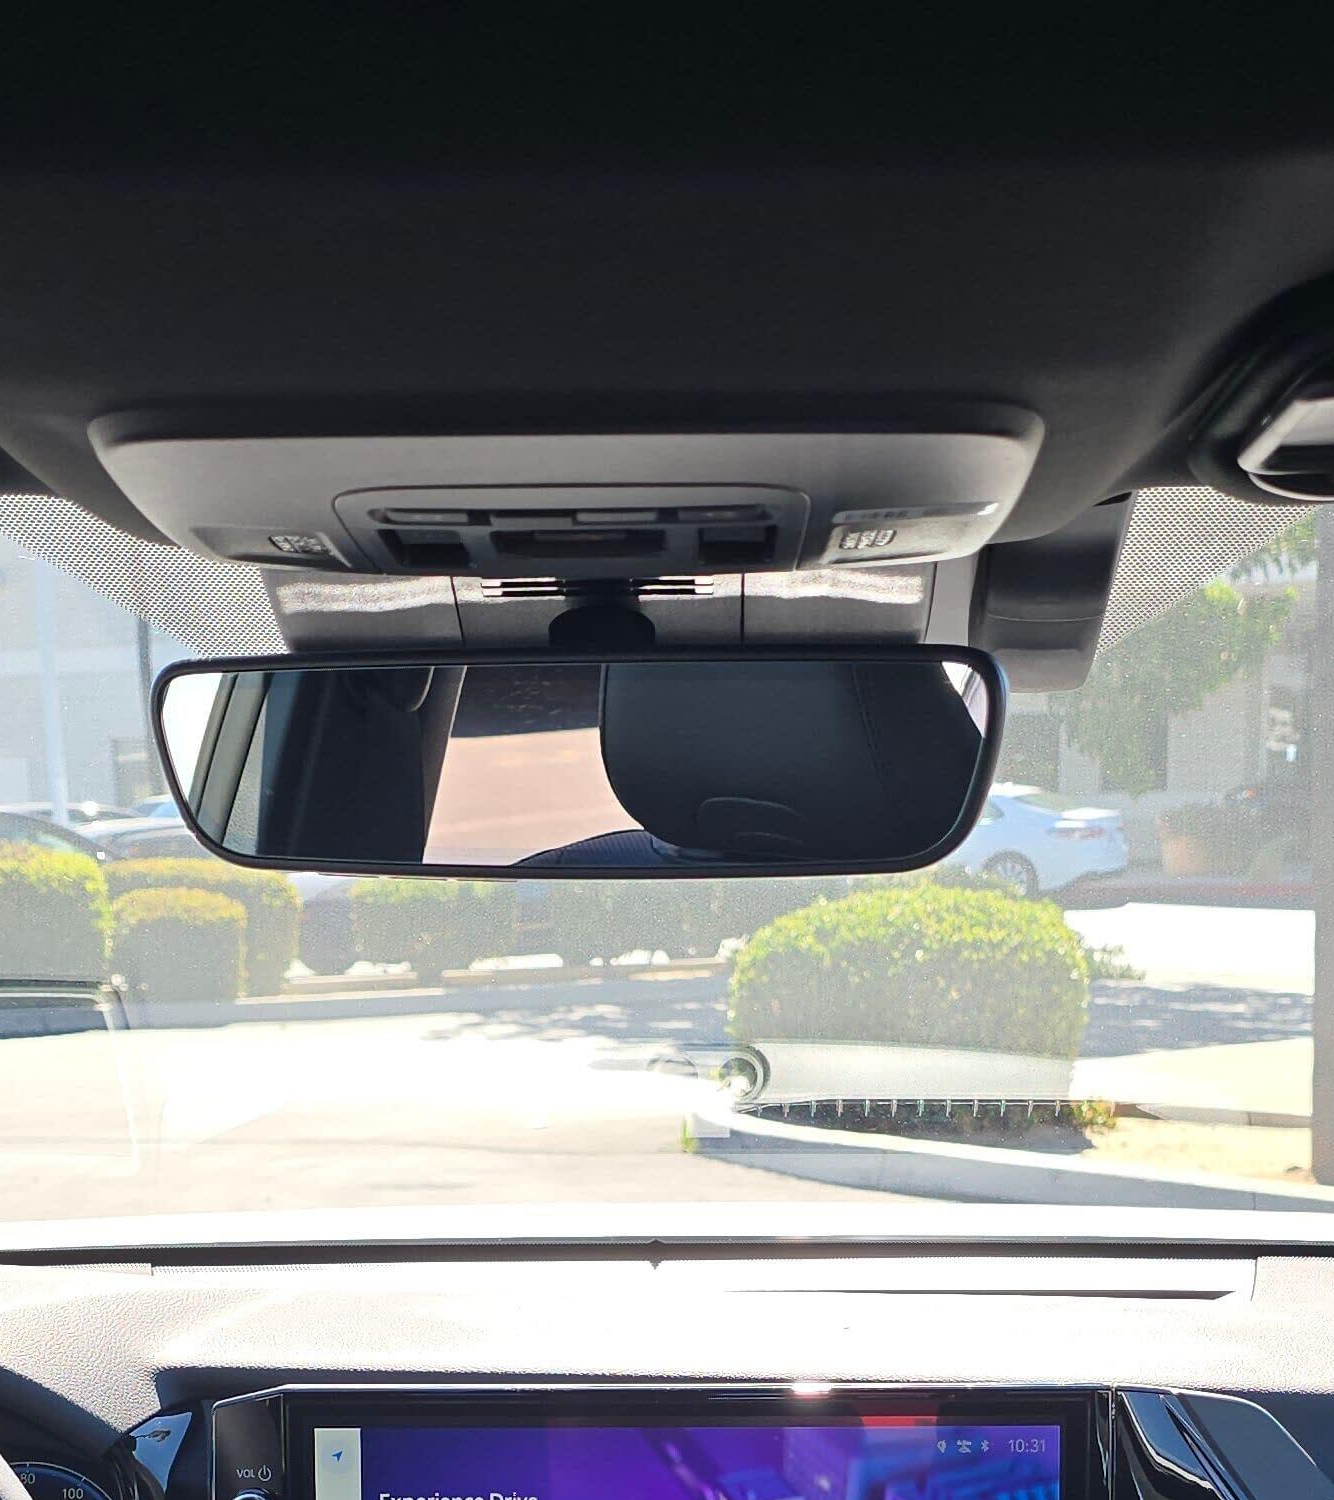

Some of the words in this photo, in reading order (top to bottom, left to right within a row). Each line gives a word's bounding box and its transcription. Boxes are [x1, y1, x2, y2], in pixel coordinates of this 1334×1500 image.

[1008, 1439, 1045, 1453] 10:31
[236, 1468, 255, 1478] VOL
[62, 1488, 84, 1500] 100
